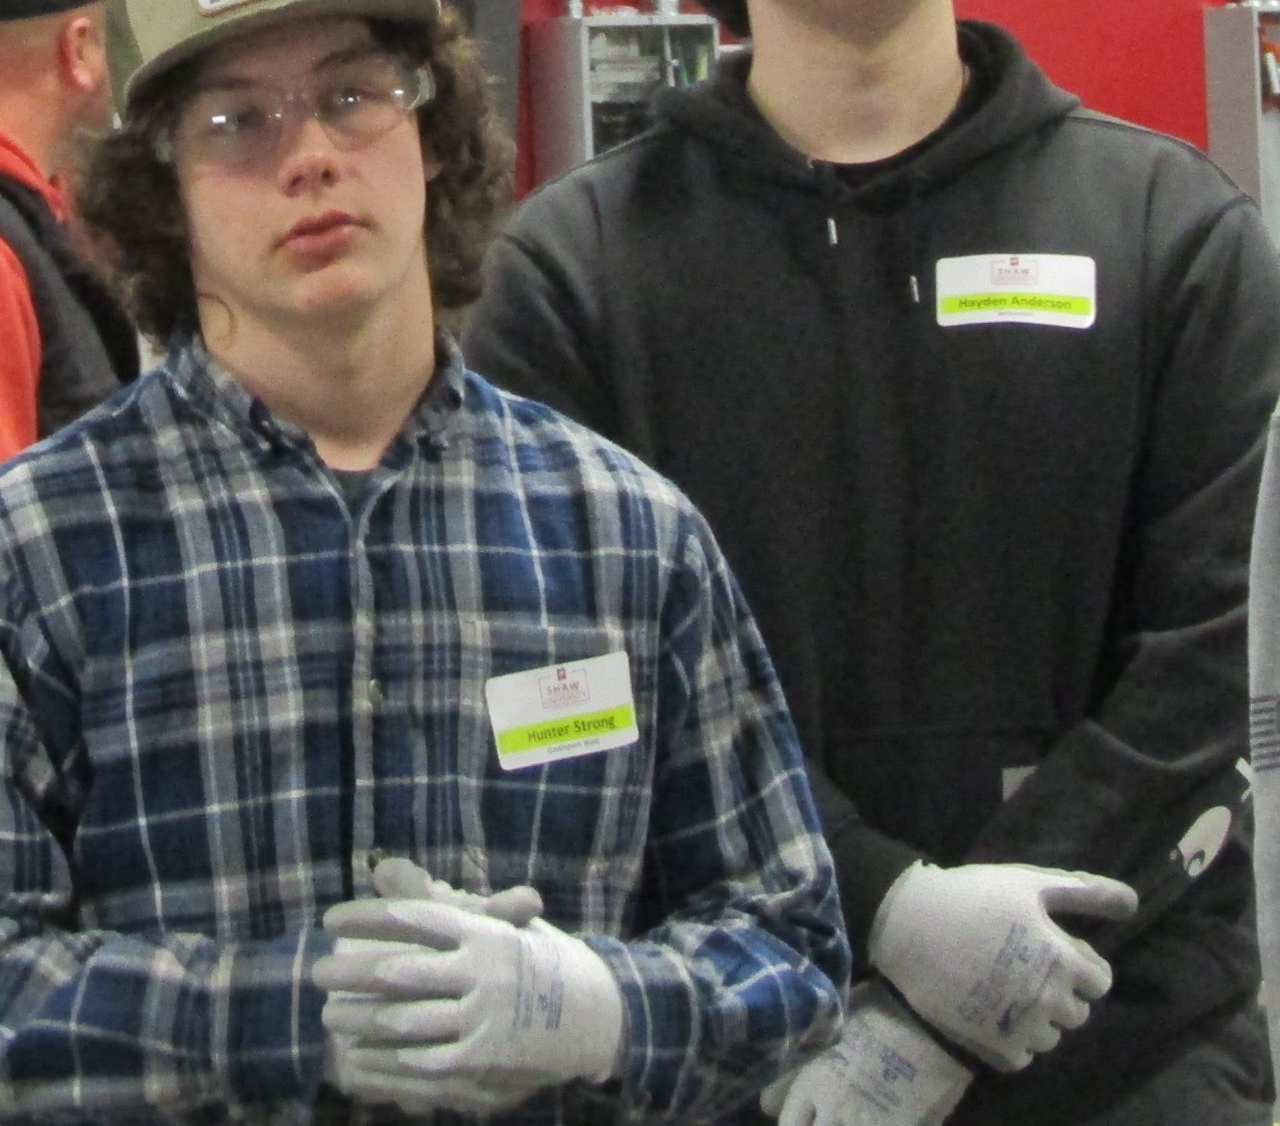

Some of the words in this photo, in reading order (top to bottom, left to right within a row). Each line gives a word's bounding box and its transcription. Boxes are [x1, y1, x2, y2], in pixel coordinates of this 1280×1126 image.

[958, 296, 1007, 309] Hayden
[1011, 296, 1072, 309] Anderson
[546, 681, 581, 693] SHAW
[527, 724, 569, 742] Hunter
[574, 716, 616, 733] Strong
